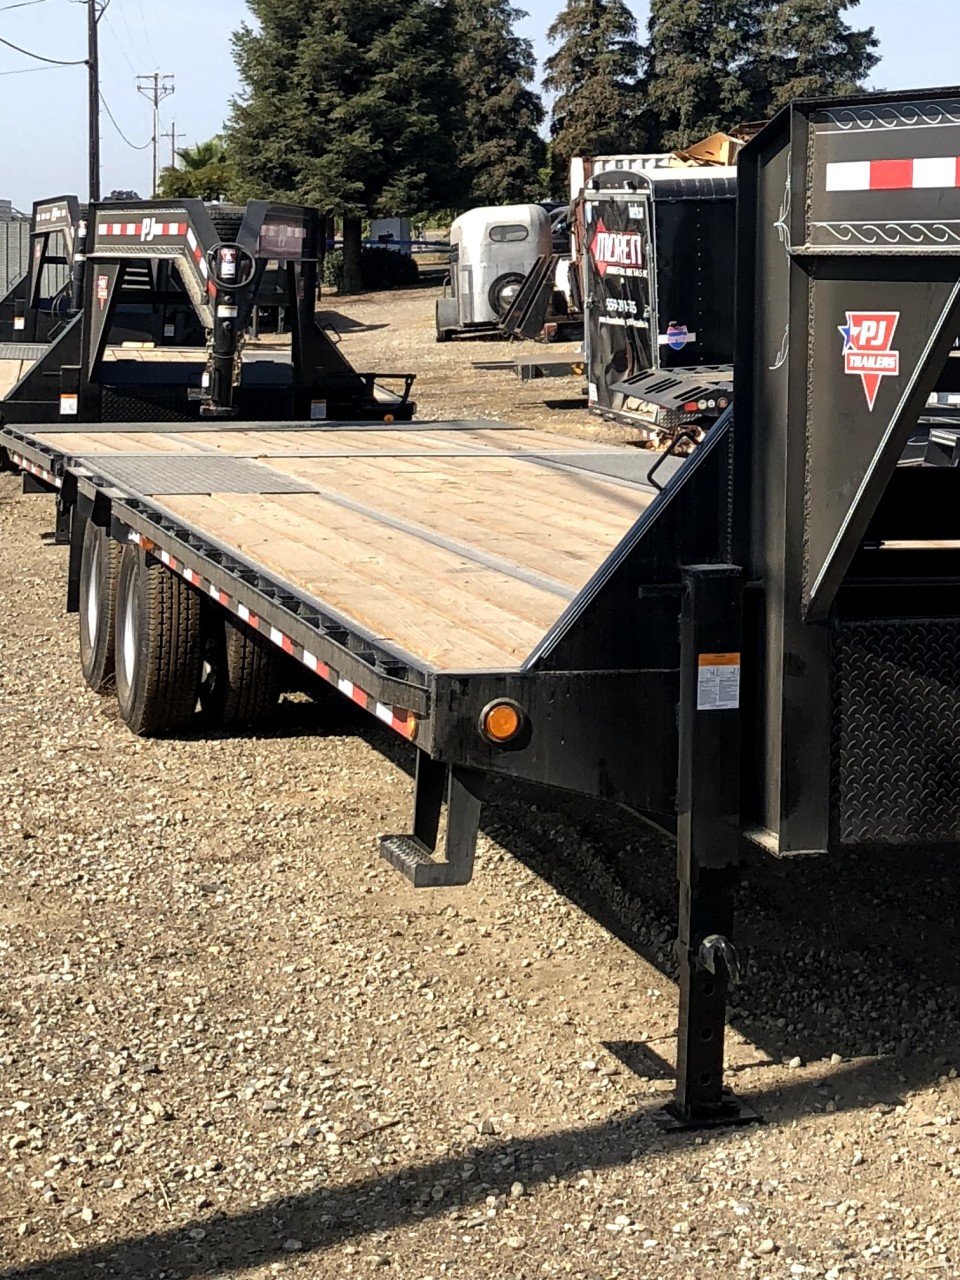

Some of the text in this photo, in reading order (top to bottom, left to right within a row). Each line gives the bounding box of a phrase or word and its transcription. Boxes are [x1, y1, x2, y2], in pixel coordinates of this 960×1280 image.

[140, 217, 157, 242] PJ
[595, 232, 643, 265] MOREN
[858, 320, 887, 346] PJ
[849, 355, 897, 369] TRAILERS
